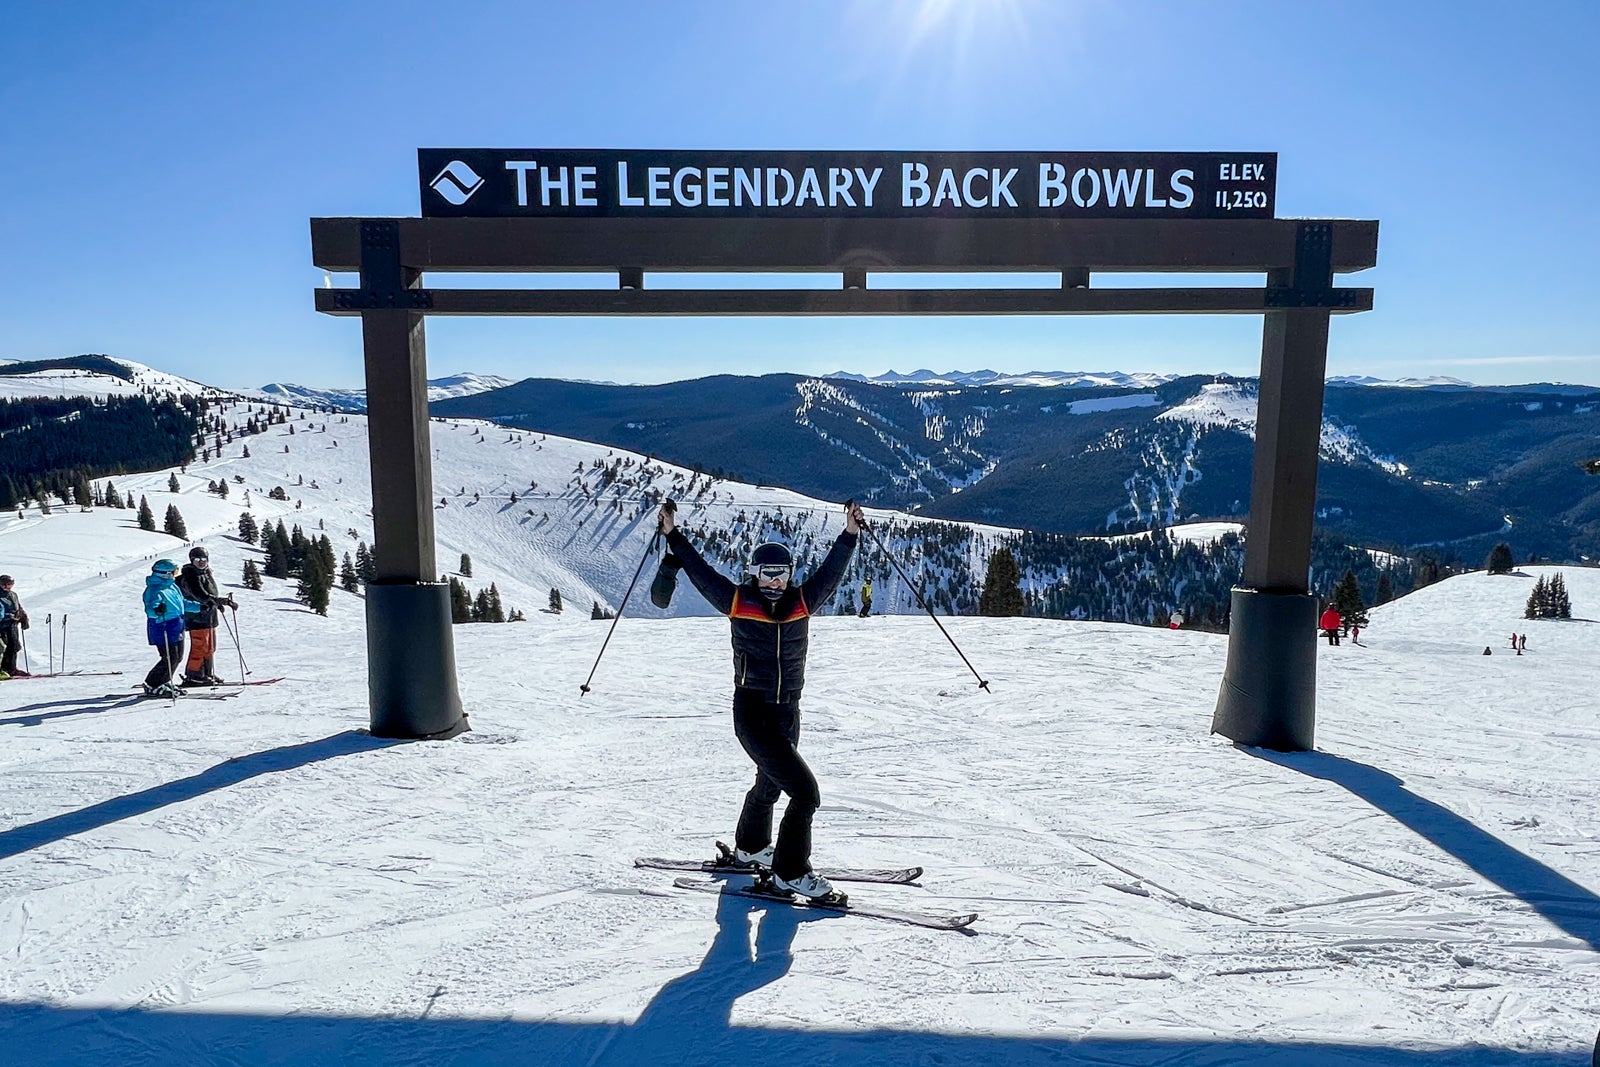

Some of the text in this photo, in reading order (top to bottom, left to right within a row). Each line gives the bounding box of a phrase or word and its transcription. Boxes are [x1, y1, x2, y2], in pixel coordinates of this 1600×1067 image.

[1219, 163, 1265, 181] ELEV.
[505, 160, 1195, 209] THE LEGENDARY BACK BOWLS
[1215, 190, 1267, 211] 11,250
